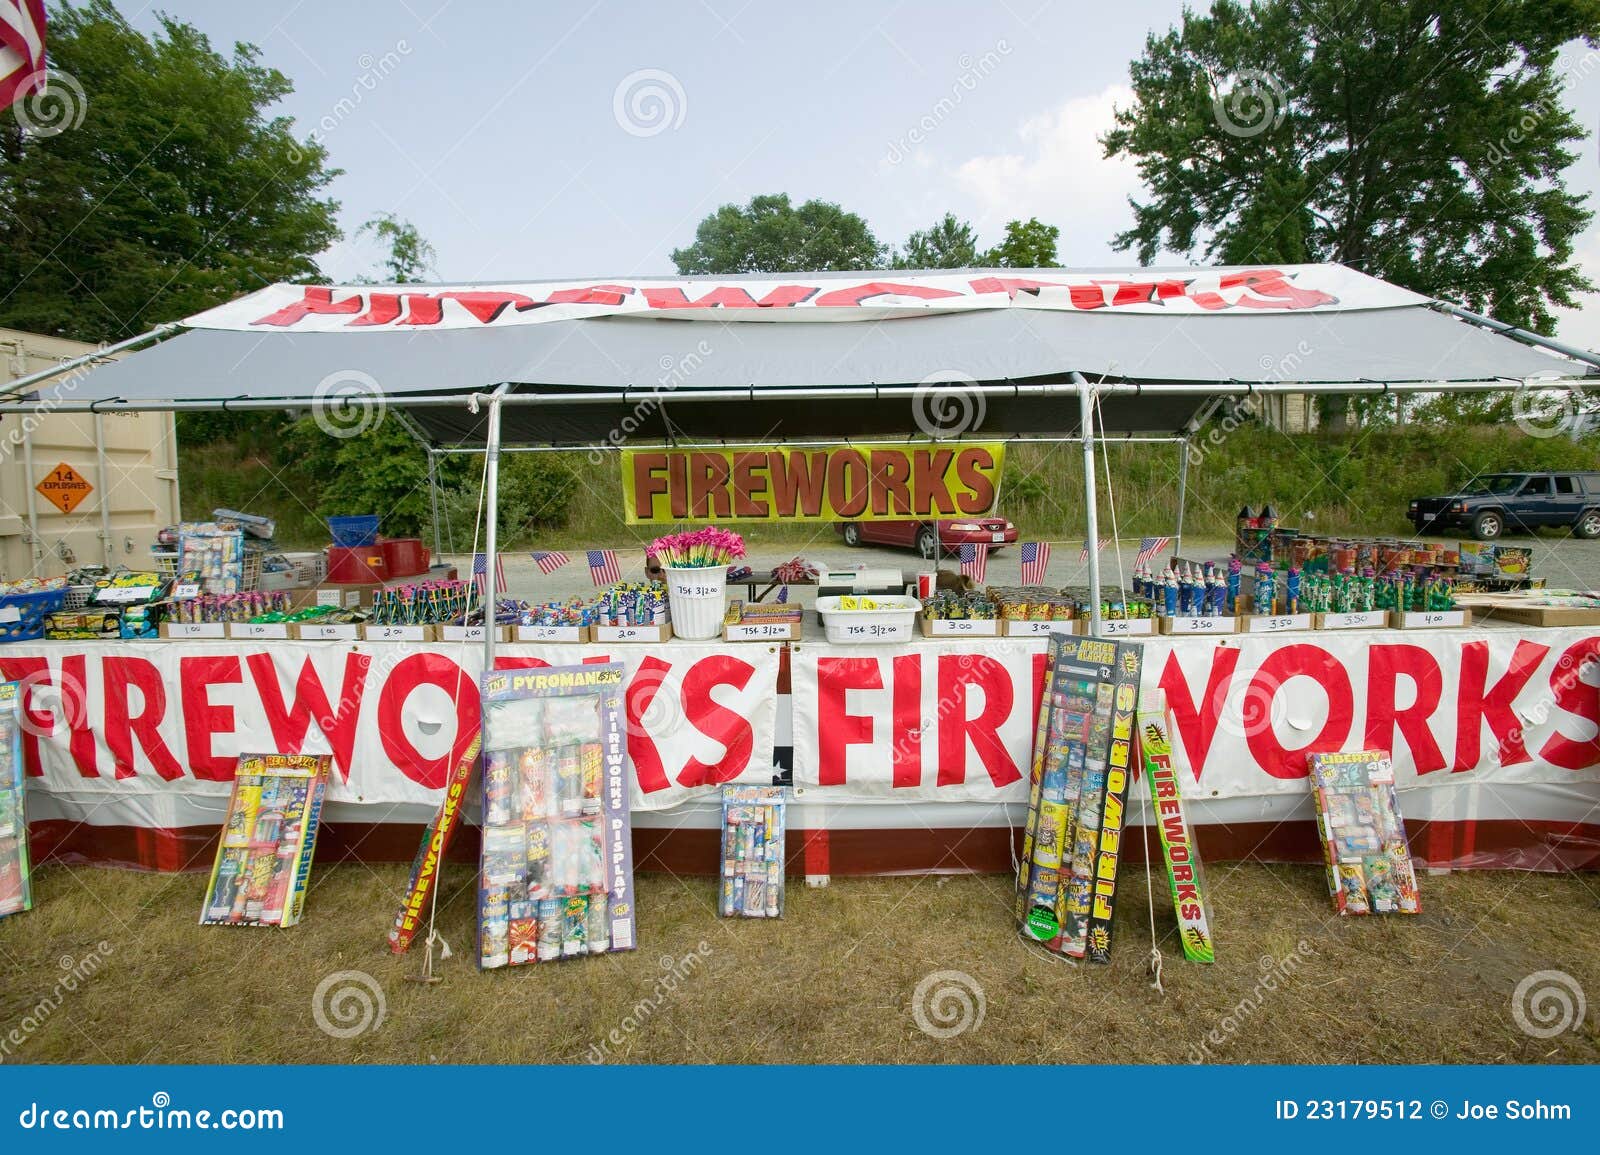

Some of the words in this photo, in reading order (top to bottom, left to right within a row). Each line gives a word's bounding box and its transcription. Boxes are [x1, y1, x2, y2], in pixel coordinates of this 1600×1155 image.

[44, 481, 87, 490] EXPLOSIVES
[56, 471, 74, 482] 1.4
[633, 447, 995, 519] FIREWORKS
[0, 650, 753, 794] FIREWOKS
[606, 711, 624, 810] FIREWORKS
[816, 636, 1600, 788] FIRWORKS
[1320, 752, 1382, 765] LIBERTY
[294, 784, 326, 893] FIREWORKS
[1092, 682, 1137, 921] FIREWORKS
[1149, 754, 1202, 921] FIREWORKS
[402, 782, 463, 931] FIREWORKS
[611, 818, 627, 900] DISPLAY
